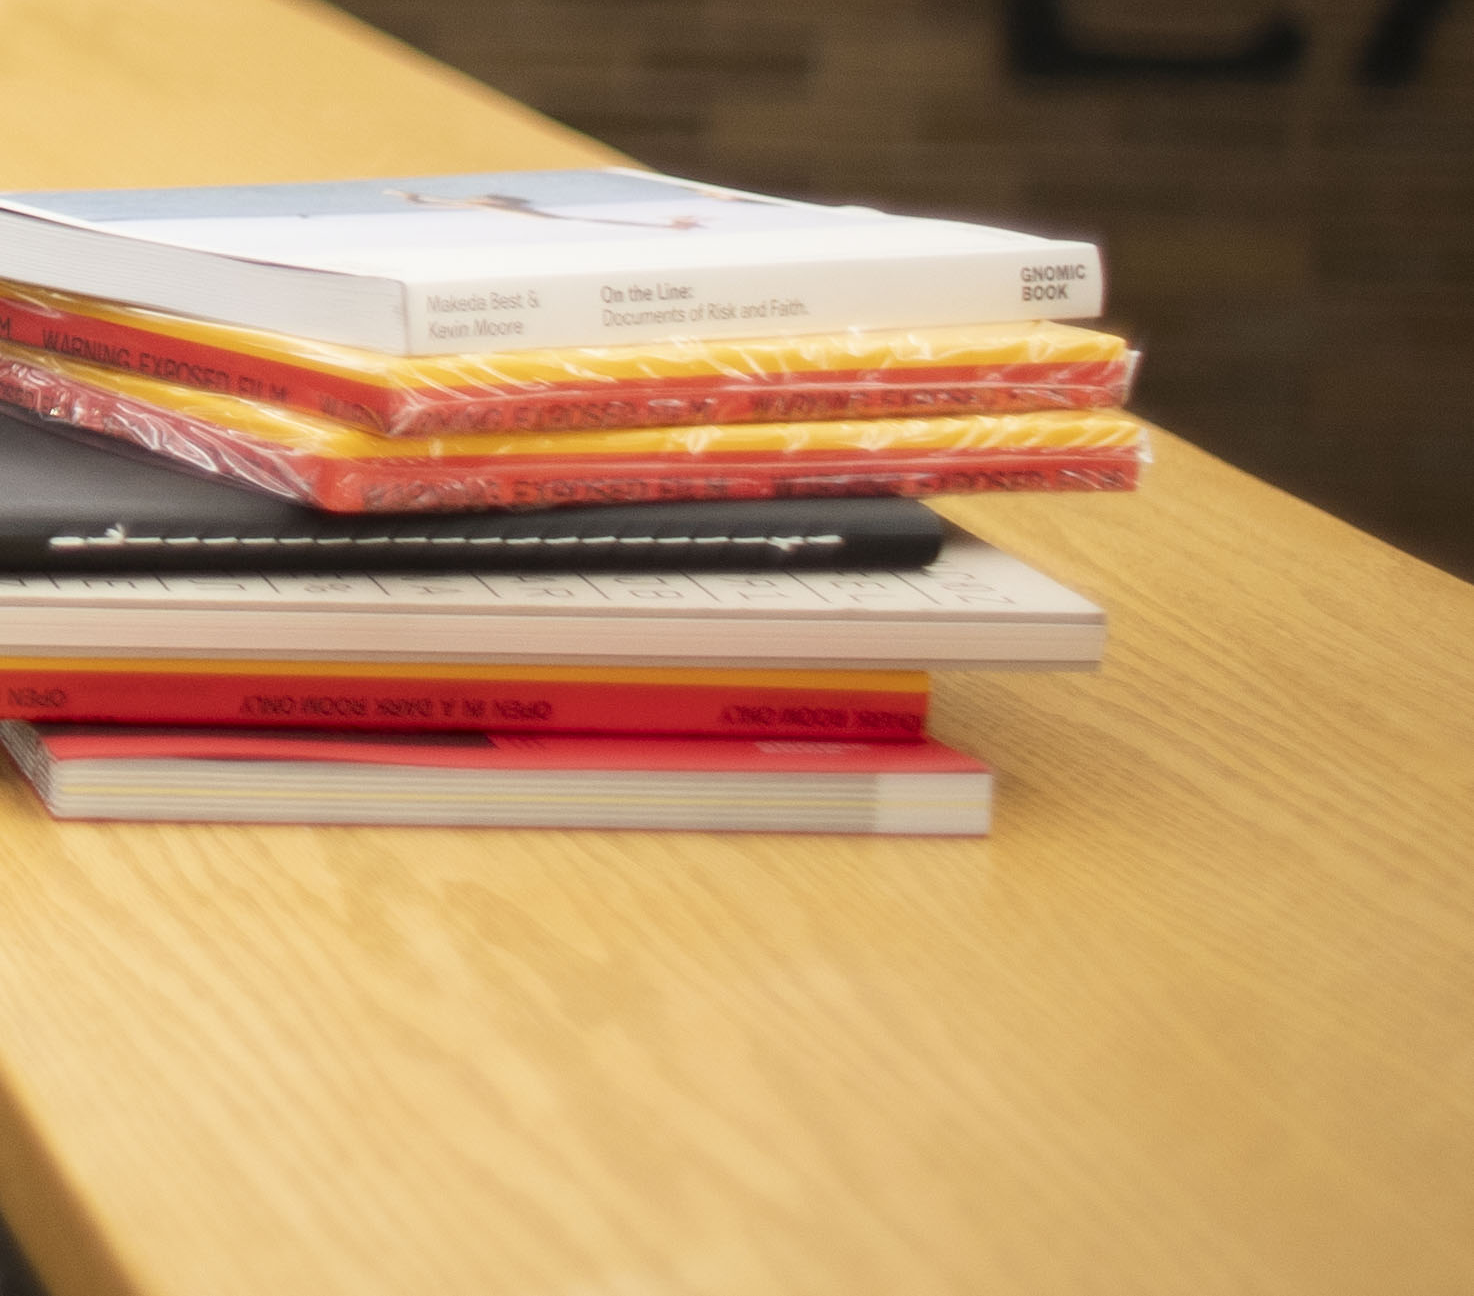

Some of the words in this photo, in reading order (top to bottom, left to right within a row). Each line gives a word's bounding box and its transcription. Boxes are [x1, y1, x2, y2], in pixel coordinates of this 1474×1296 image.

[1020, 264, 1086, 283] GNOMIC
[427, 293, 487, 314] Makeda
[490, 290, 524, 311] Best
[527, 289, 540, 309] &
[600, 285, 624, 304] On
[628, 284, 653, 302] the
[657, 282, 693, 301] Line:
[1022, 284, 1069, 301] BOOK
[602, 309, 686, 327] Documents
[690, 305, 705, 321] of
[707, 303, 737, 320] Risk
[741, 301, 766, 318] and
[428, 321, 470, 340] Kevin
[474, 318, 525, 337] Moore
[42, 328, 132, 369] WARNING
[139, 352, 231, 392] EXPOSED
[238, 374, 288, 402] FILM
